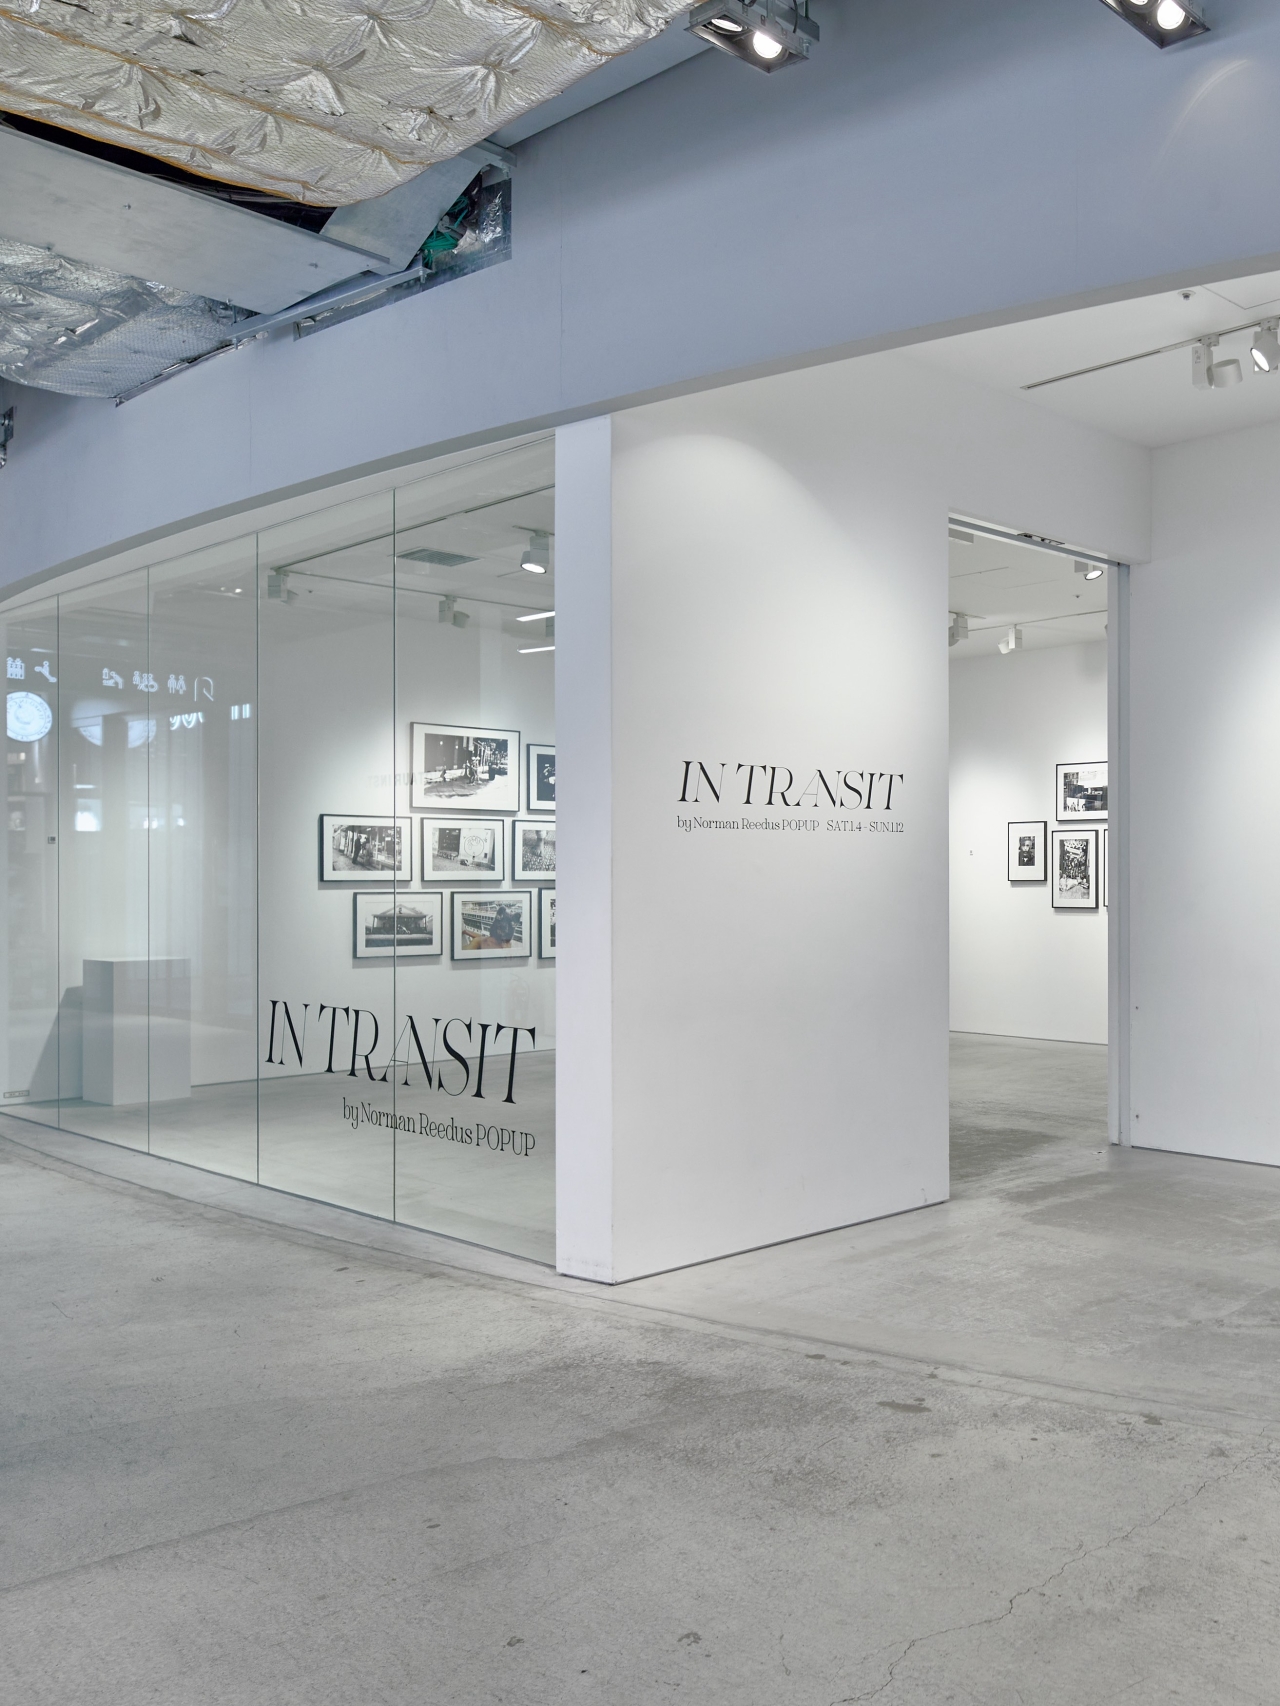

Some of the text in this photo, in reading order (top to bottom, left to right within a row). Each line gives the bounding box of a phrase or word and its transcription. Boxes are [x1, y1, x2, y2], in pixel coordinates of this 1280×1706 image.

[677, 760, 904, 810] IN TRANSIT
[677, 815, 692, 833] by
[693, 816, 740, 830] Norman
[741, 818, 781, 831] Reedus
[782, 819, 820, 831] POPUP
[264, 999, 536, 1105] IN TRANSIT
[343, 1097, 536, 1157] by Norman Reedus POPUP
